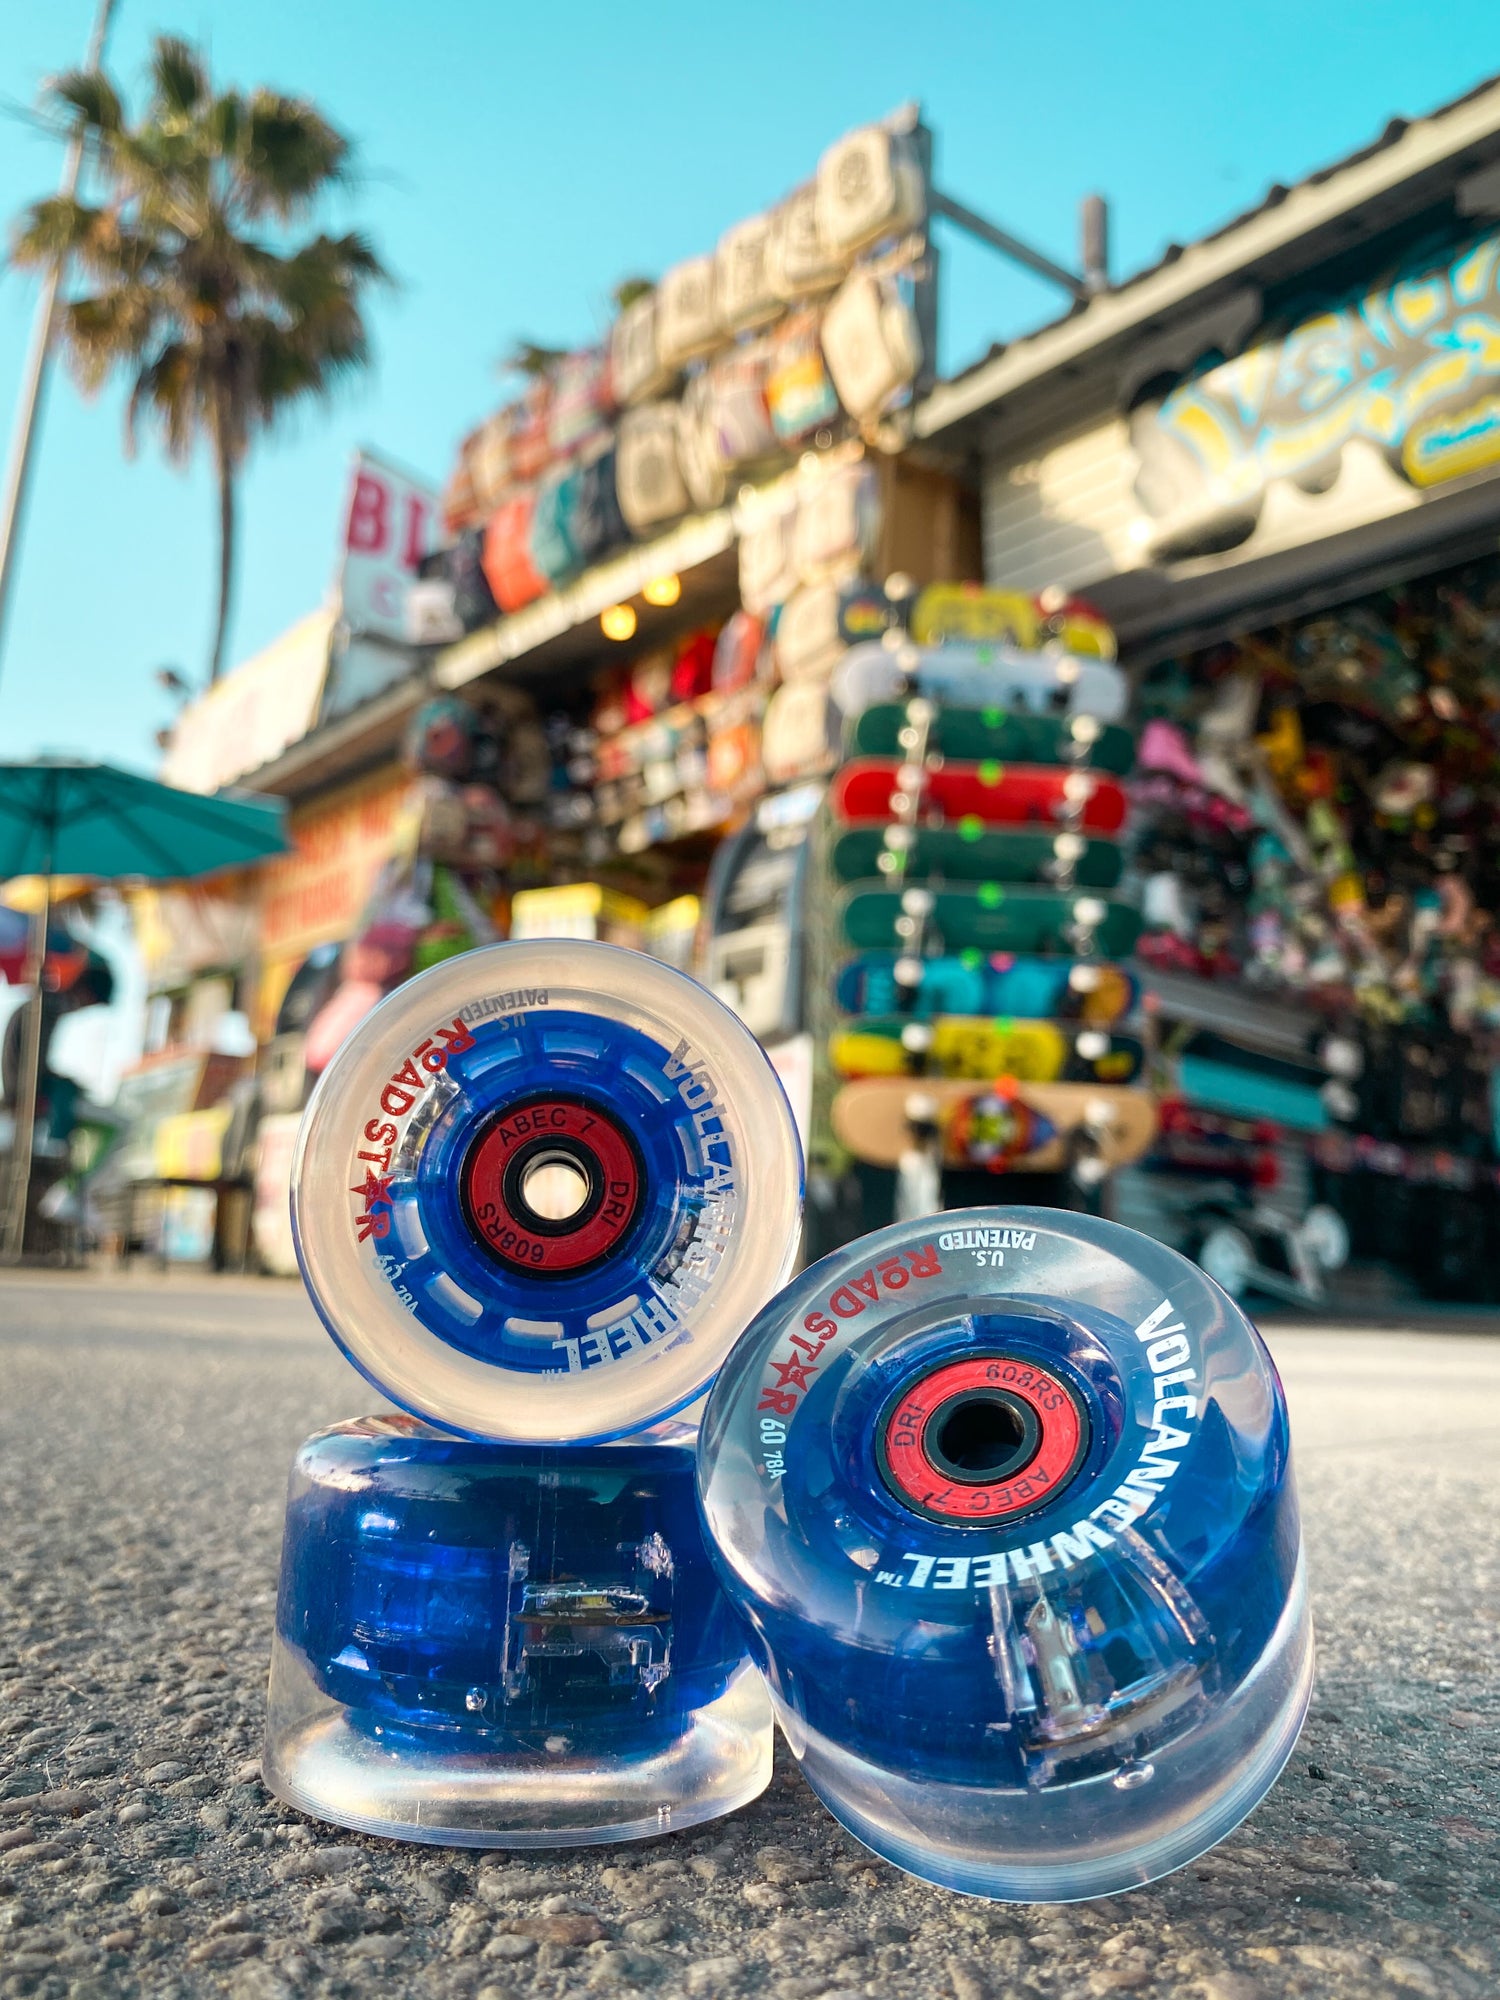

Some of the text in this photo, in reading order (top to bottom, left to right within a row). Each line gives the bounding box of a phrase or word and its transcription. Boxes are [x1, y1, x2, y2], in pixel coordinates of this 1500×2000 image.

[459, 988, 549, 1023] PATENTED
[498, 1107, 597, 1148] ABEC 7
[600, 1180, 630, 1229] DRI
[477, 1202, 545, 1263] 608RS
[938, 1229, 1037, 1251] PATENTED
[971, 1250, 1005, 1267] U.S.
[396, 1284, 419, 1314] 78A
[985, 1363, 1065, 1412] 608RS
[893, 1402, 927, 1447] DRI
[759, 1417, 788, 1480] 60 78A
[970, 1465, 1051, 1512] ABEC
